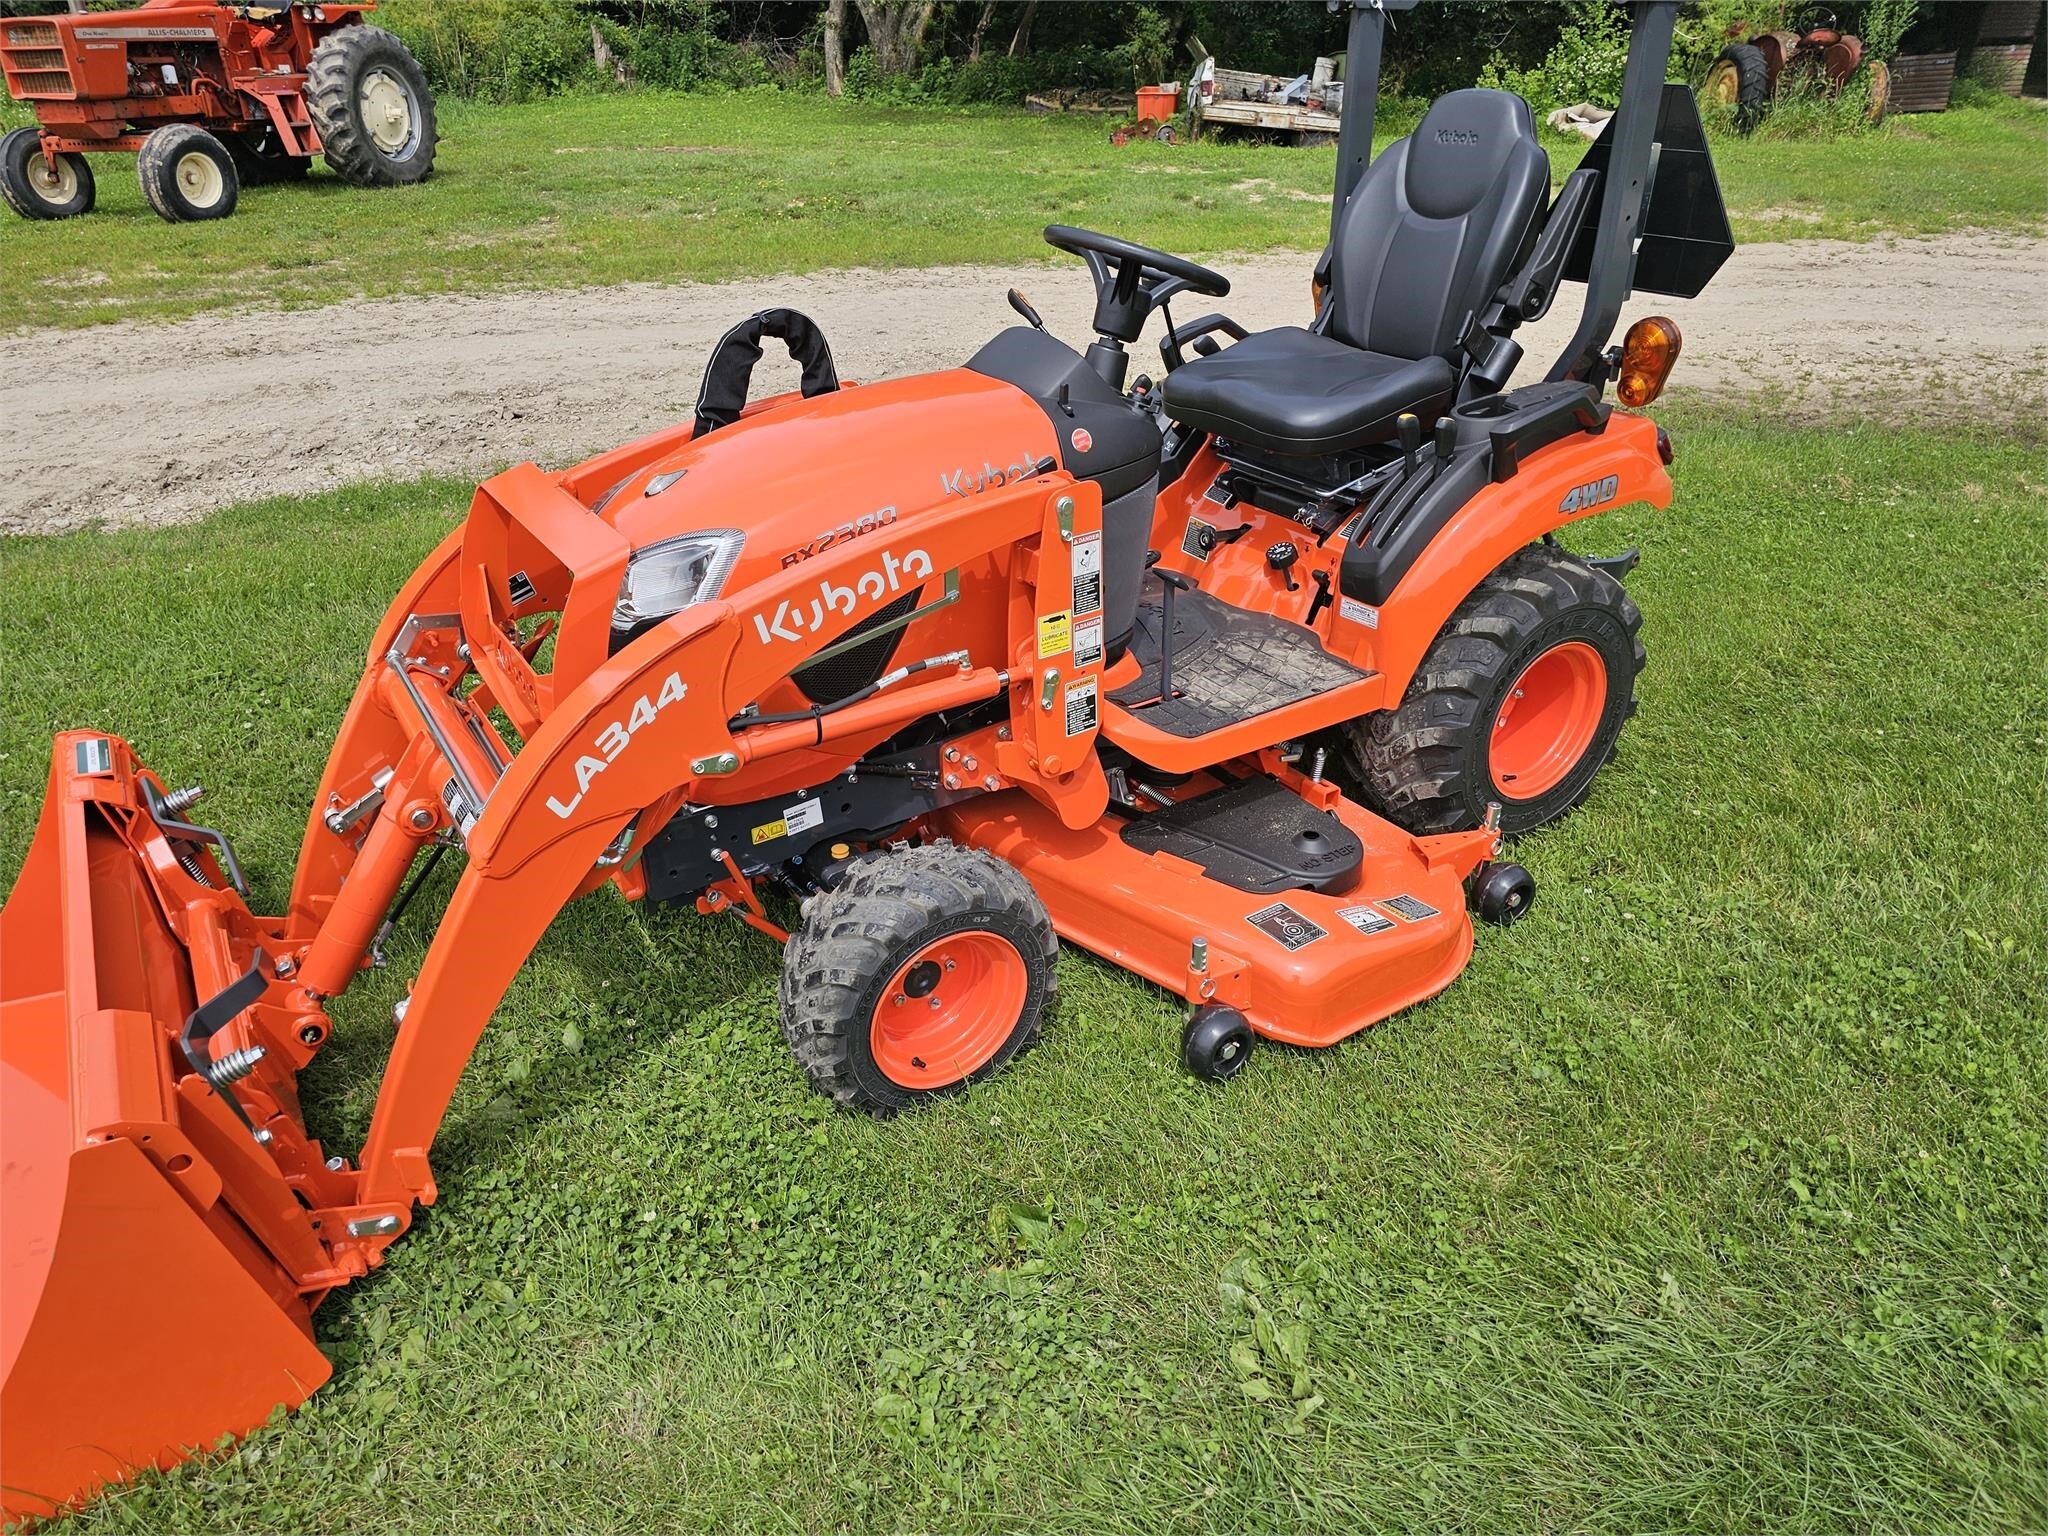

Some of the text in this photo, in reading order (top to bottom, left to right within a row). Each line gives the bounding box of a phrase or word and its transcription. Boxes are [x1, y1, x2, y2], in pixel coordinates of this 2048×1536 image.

[1435, 129, 1479, 145] Kubota
[1558, 473, 1619, 515] 4WD
[752, 549, 934, 646] Kubota
[545, 671, 689, 819] LA344
